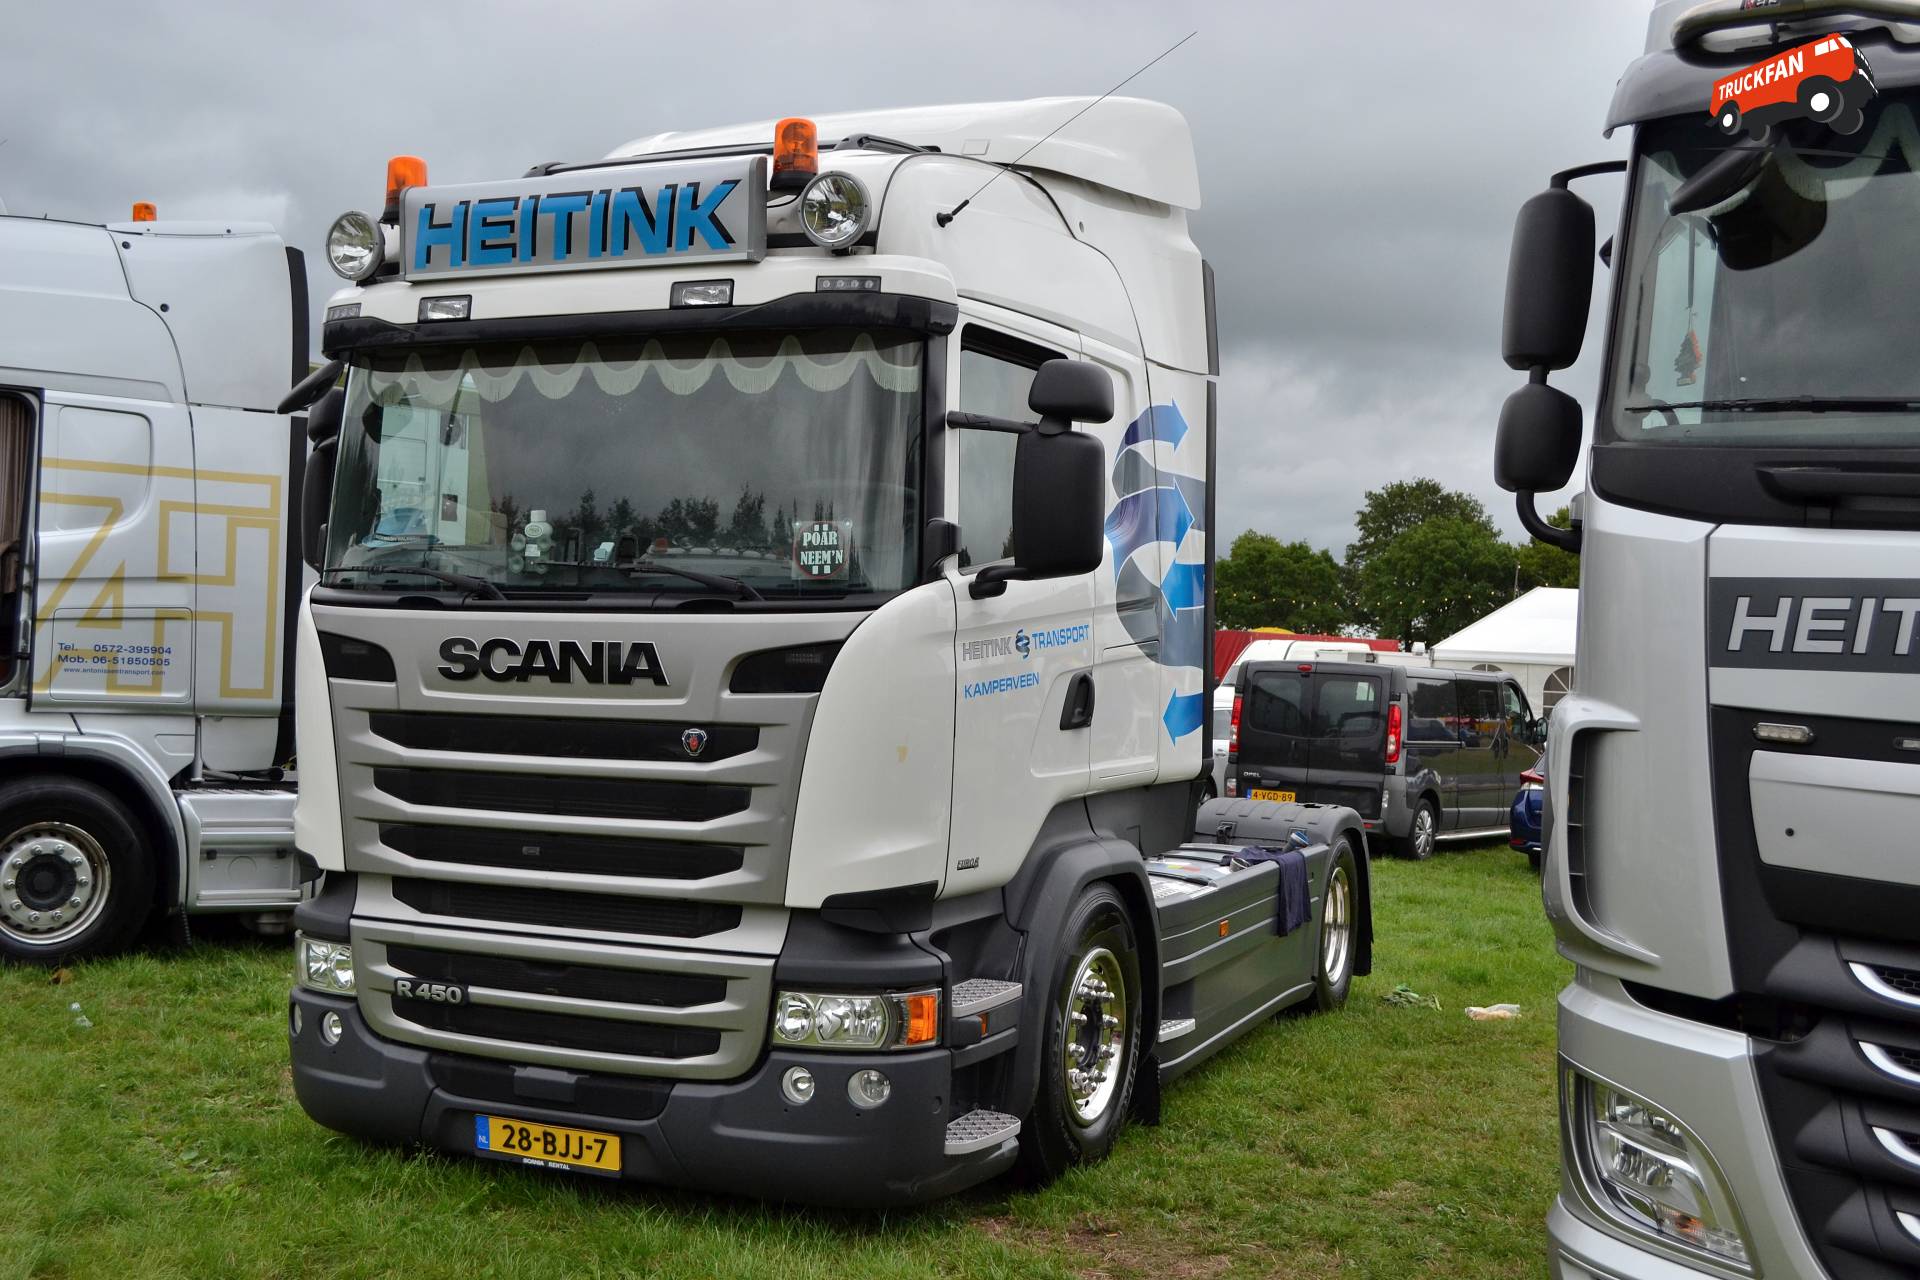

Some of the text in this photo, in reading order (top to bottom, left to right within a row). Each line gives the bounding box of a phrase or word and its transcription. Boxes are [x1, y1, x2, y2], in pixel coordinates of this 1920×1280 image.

[414, 179, 740, 270] HEITINK
[802, 531, 838, 546] POAR
[800, 550, 844, 565] NEEM'N
[1727, 596, 1920, 655] HEIT
[57, 642, 172, 655] Tel. 0572-395904
[962, 624, 1090, 661] HEITINK TRANSPORT
[57, 654, 170, 666] Mob. 06-51850505
[436, 636, 671, 687] SCANIA
[964, 672, 1040, 699] KAMPERVEEN
[397, 980, 462, 1004] R 450
[479, 1135, 488, 1144] NL
[502, 1124, 608, 1163] 28-BJJ-7
